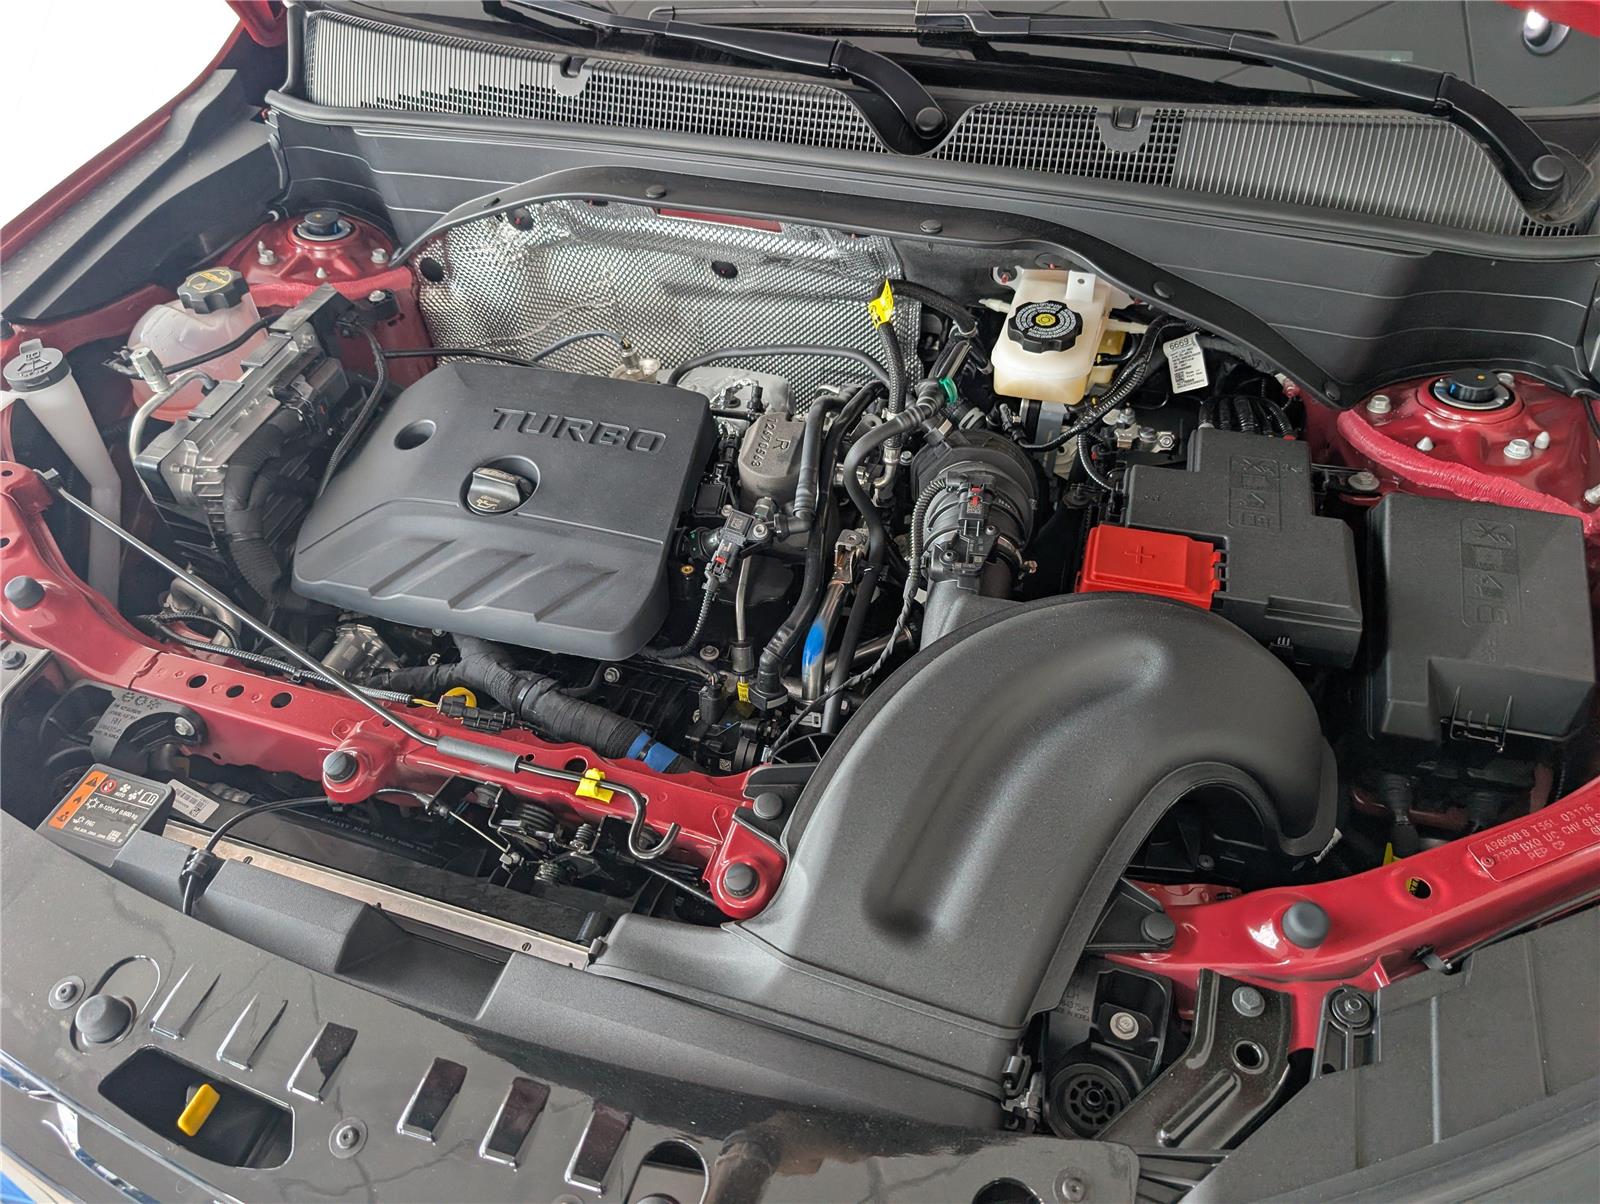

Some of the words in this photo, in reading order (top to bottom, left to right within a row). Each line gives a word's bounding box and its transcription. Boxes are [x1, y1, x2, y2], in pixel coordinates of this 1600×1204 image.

[1169, 337, 1190, 350] 6669
[493, 407, 667, 454] TURBO
[773, 438, 791, 450] R
